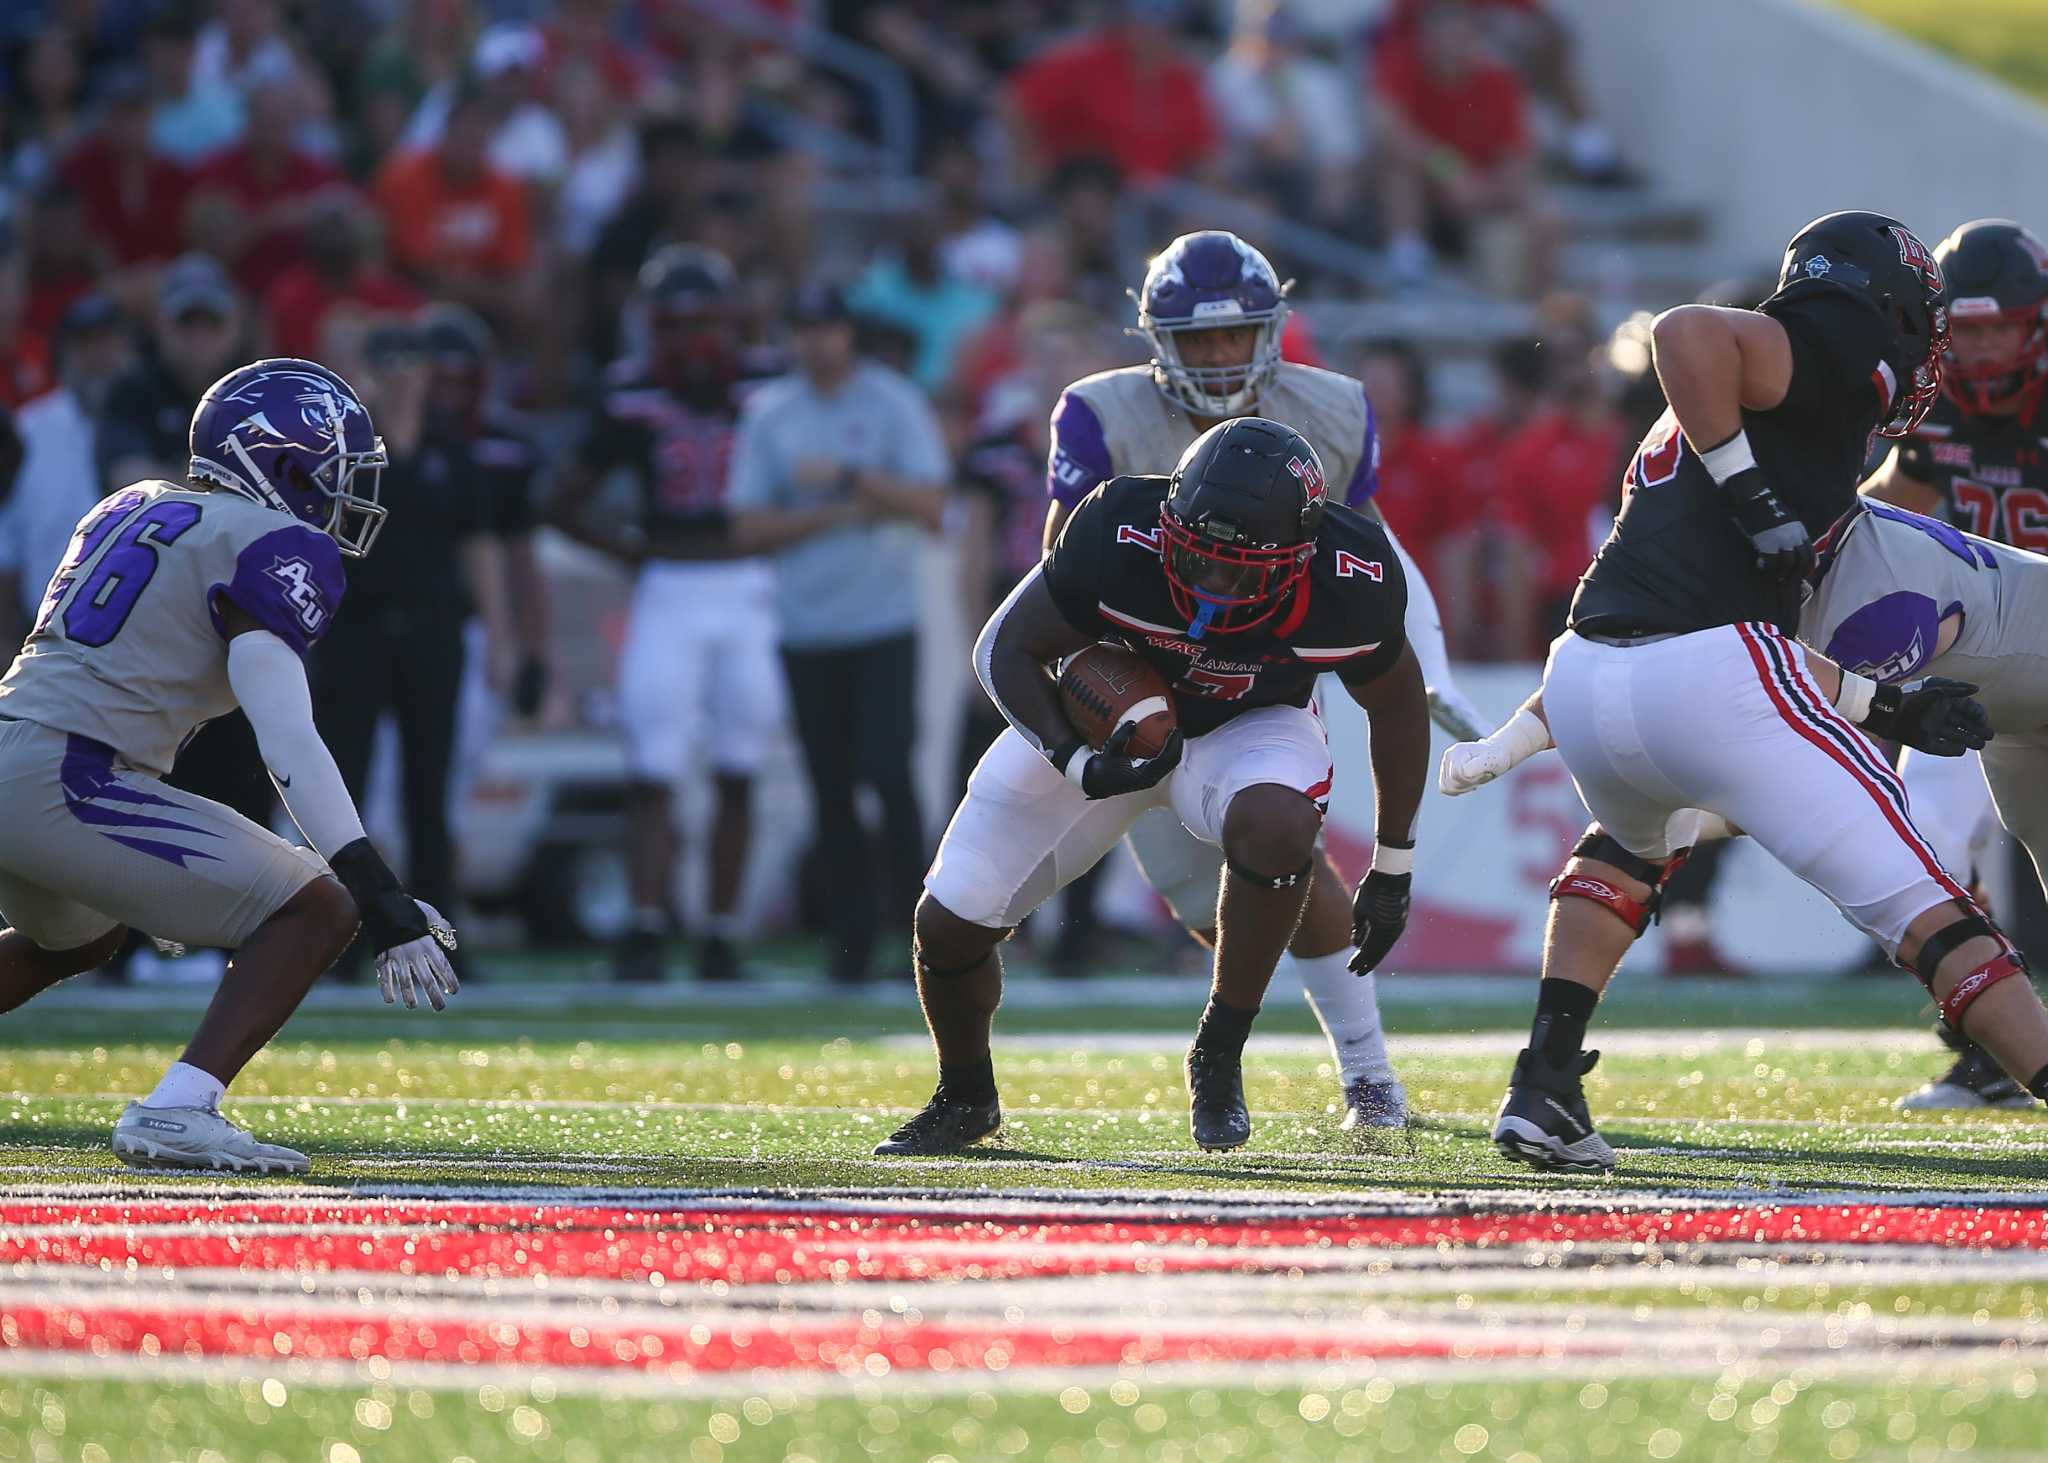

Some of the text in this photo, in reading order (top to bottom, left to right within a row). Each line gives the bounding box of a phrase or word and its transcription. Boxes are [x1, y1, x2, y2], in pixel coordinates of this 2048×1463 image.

[1335, 550, 1384, 583] 7
[274, 561, 323, 629] ACU
[1188, 656, 1263, 673] LAMAR
